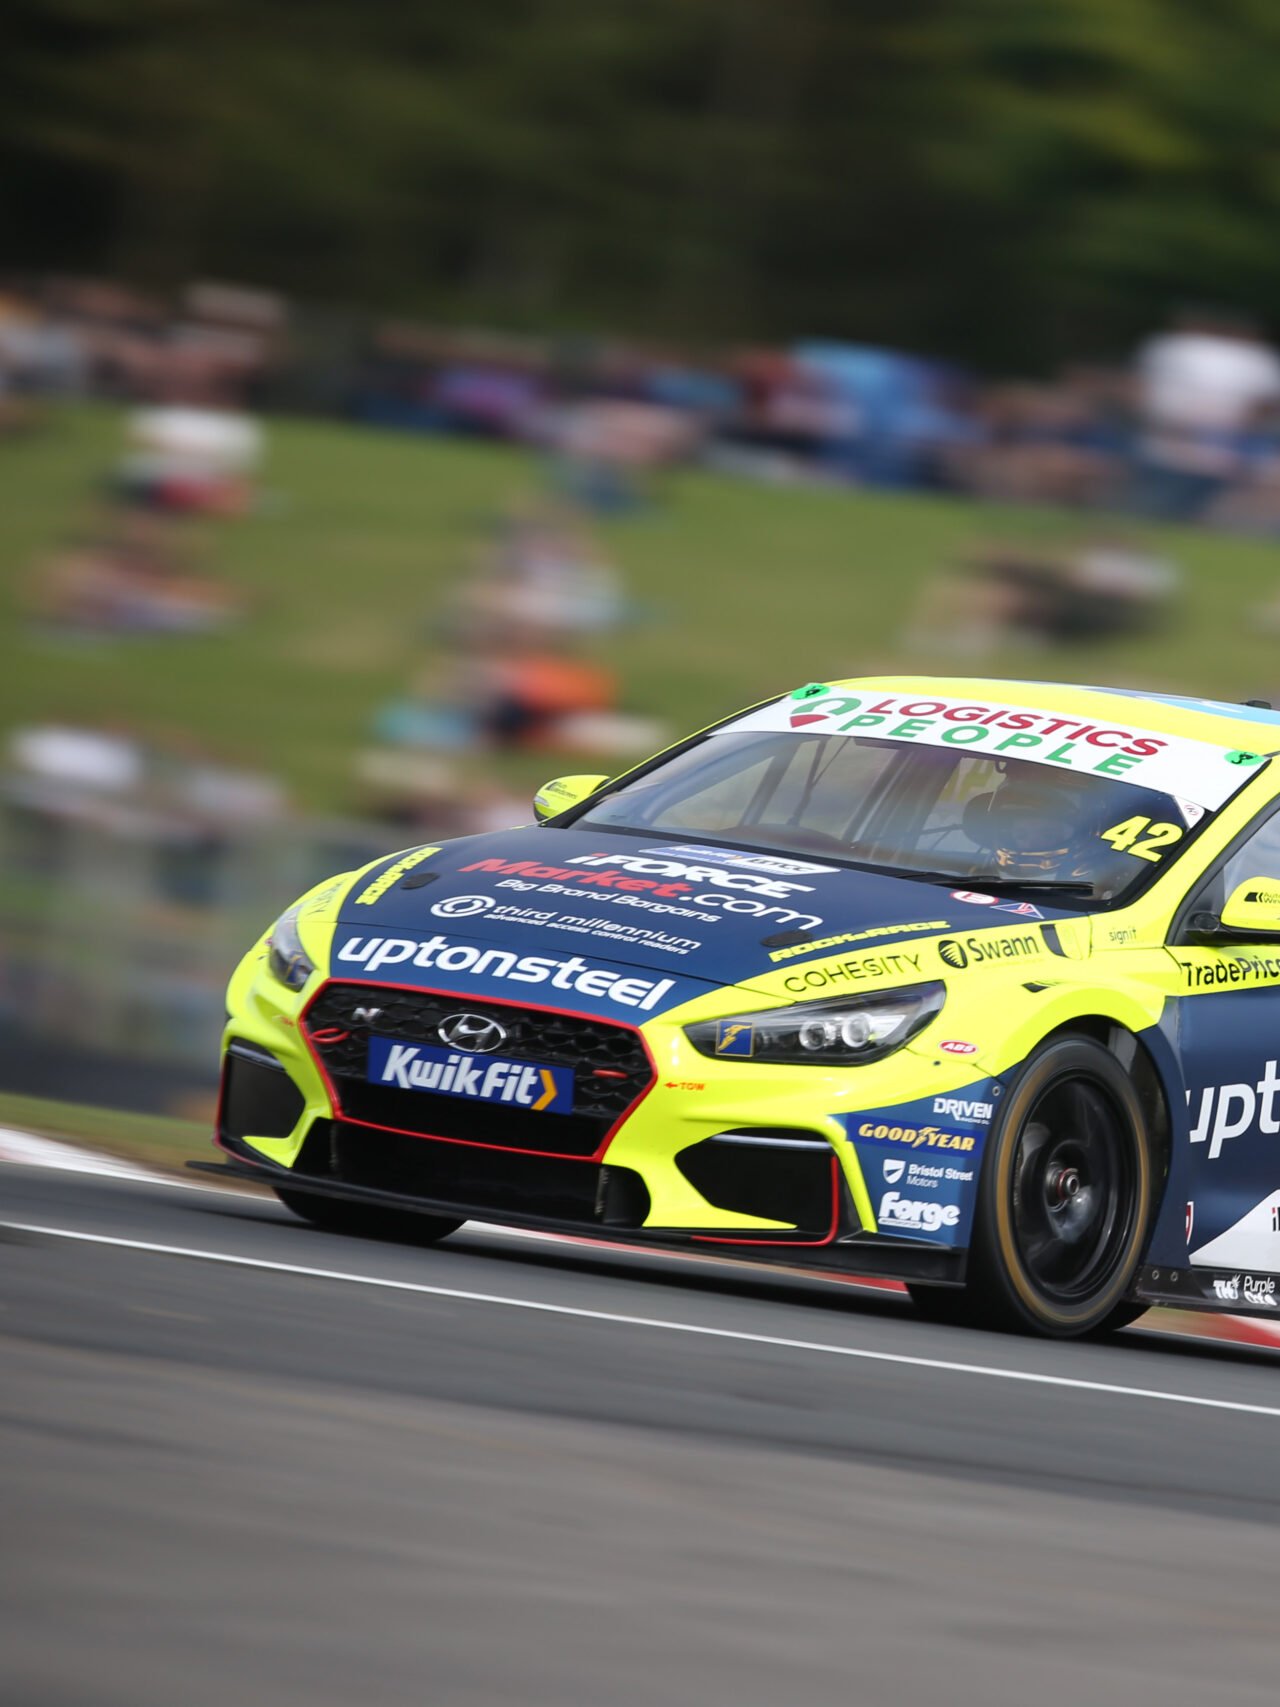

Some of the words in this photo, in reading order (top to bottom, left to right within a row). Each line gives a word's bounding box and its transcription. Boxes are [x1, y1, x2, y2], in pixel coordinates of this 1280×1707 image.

[838, 714, 1147, 776] PEOPLE
[865, 698, 1169, 757] LOGISTICS
[1101, 815, 1183, 864] 42
[457, 858, 824, 931] Market.com
[565, 852, 816, 898] iFORCE
[494, 879, 537, 891] Big
[535, 884, 615, 901] Brand
[611, 892, 723, 923] Bargains
[483, 913, 549, 926] advanced
[546, 922, 592, 935] access
[591, 928, 640, 943] control
[638, 938, 691, 956] readers
[493, 905, 558, 921] third
[557, 914, 702, 950] millennium
[966, 932, 1040, 963] Swann
[337, 936, 677, 1011] uptonsteel
[784, 953, 922, 993] COHESITY
[933, 1097, 993, 1121] DRIVEN
[906, 1175, 939, 1188] Motors
[908, 1164, 945, 1178] Bristol
[944, 1169, 974, 1182] Street
[879, 1191, 961, 1231] Forge
[1243, 1275, 1276, 1295] Purple
